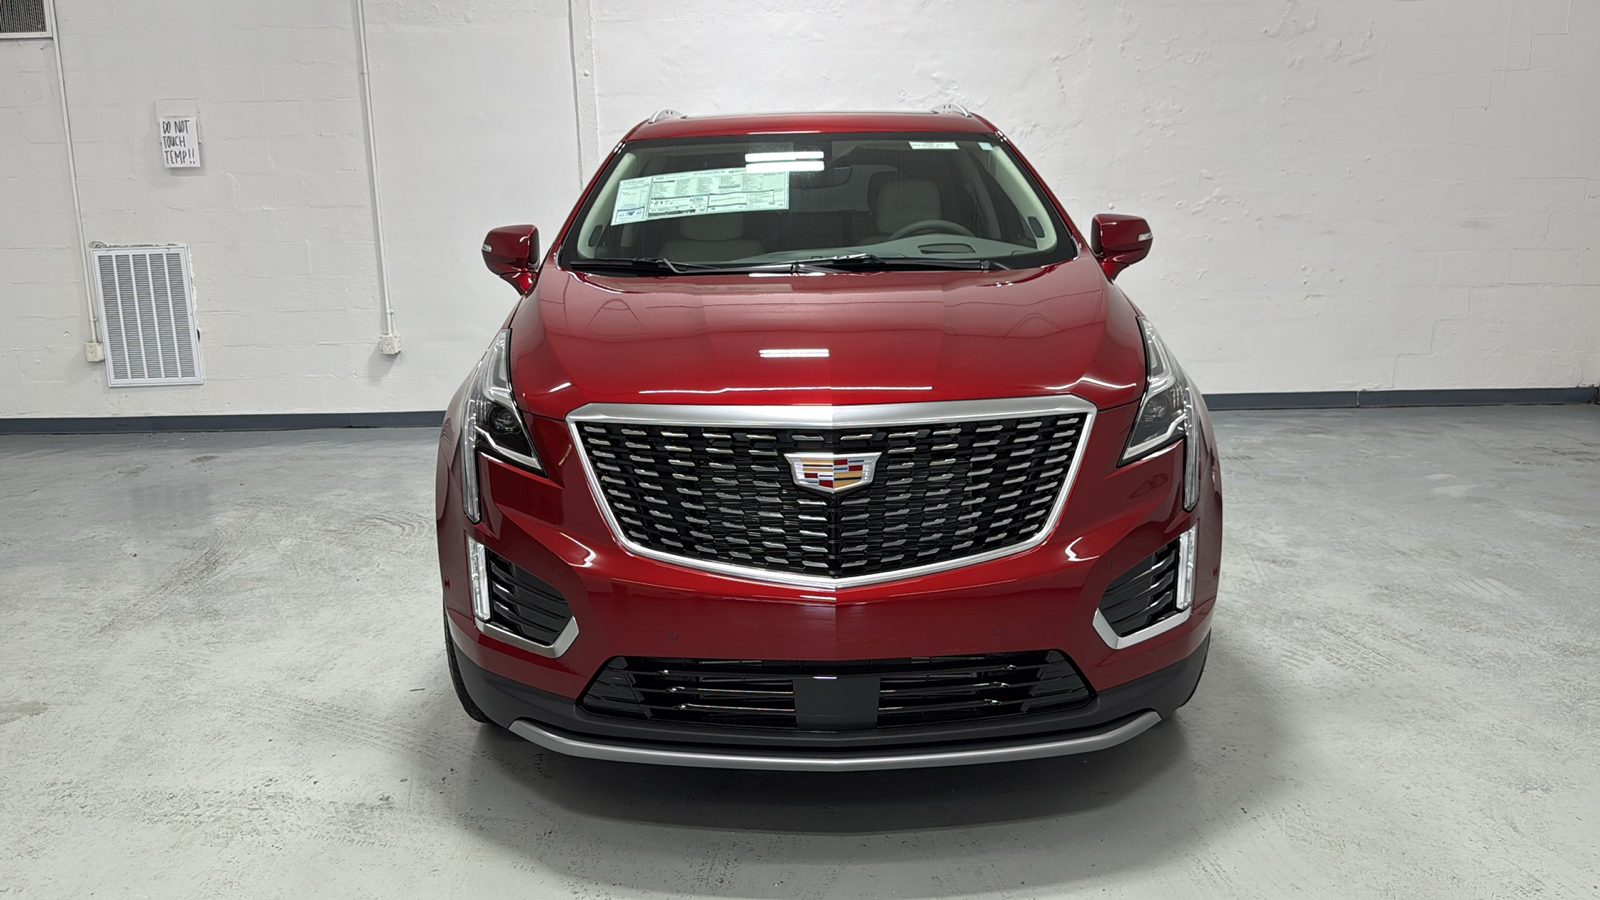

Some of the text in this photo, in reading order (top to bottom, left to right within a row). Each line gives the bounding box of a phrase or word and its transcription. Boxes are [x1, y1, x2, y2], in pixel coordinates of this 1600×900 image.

[162, 120, 190, 134] DO NOT
[162, 135, 186, 149] TOUCH
[164, 148, 195, 165] TEMP!!
